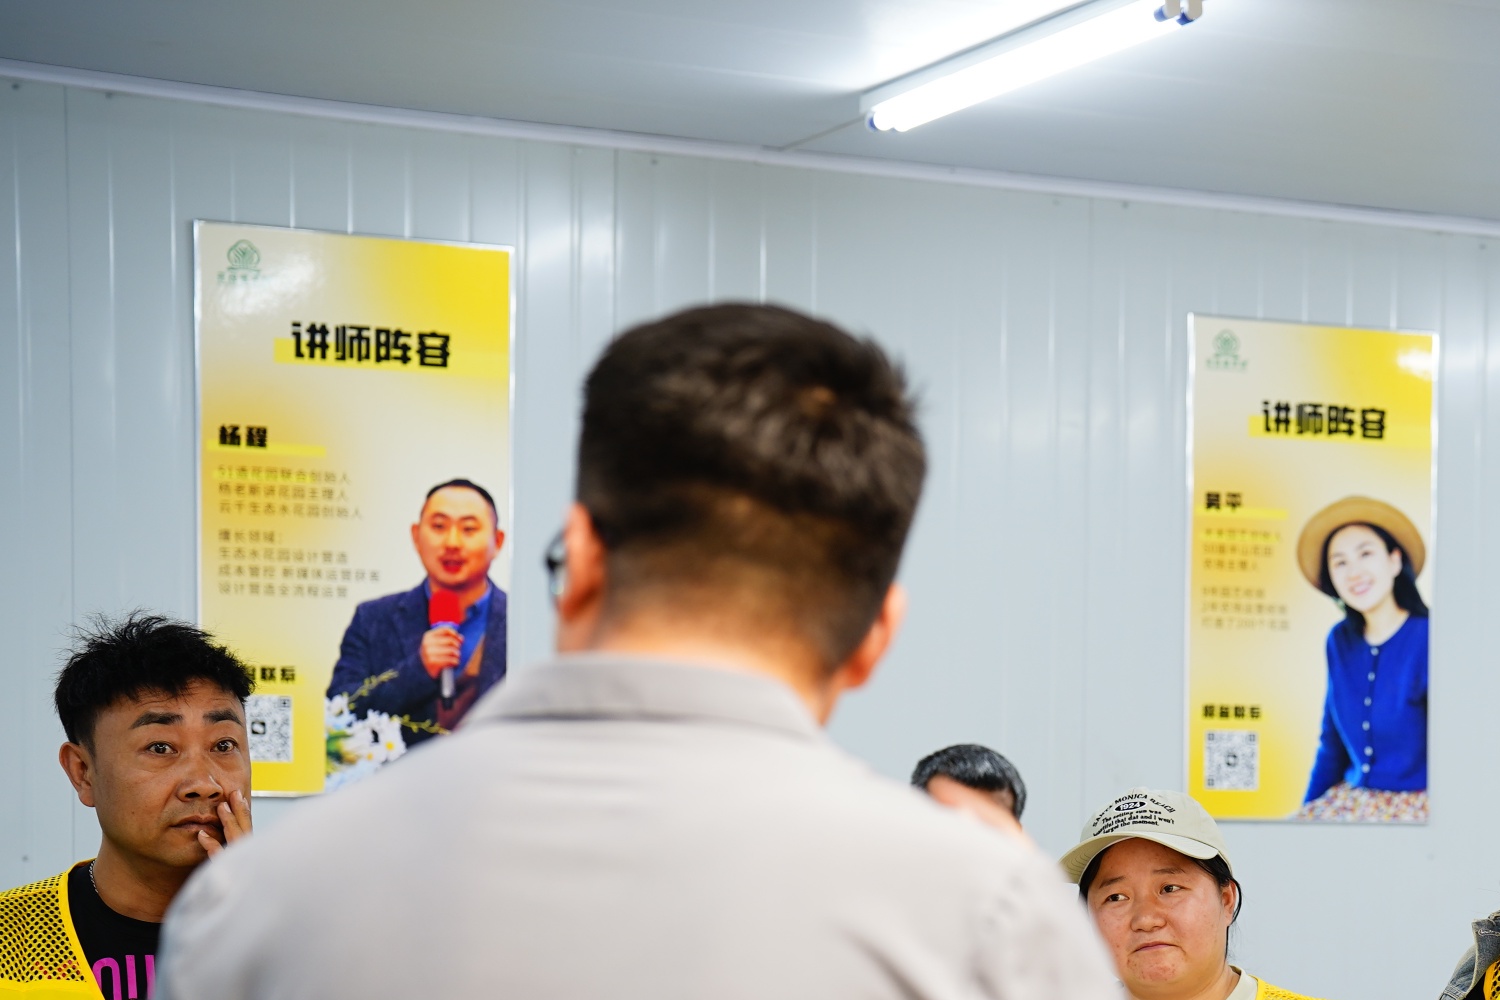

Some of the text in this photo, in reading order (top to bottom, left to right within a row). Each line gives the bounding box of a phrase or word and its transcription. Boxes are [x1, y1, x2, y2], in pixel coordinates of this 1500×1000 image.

[291, 322, 451, 368] 讲师阵容
[1262, 401, 1386, 439] 讲师阵容
[1115, 794, 1148, 804] MONICA
[1120, 802, 1141, 811] 1924
